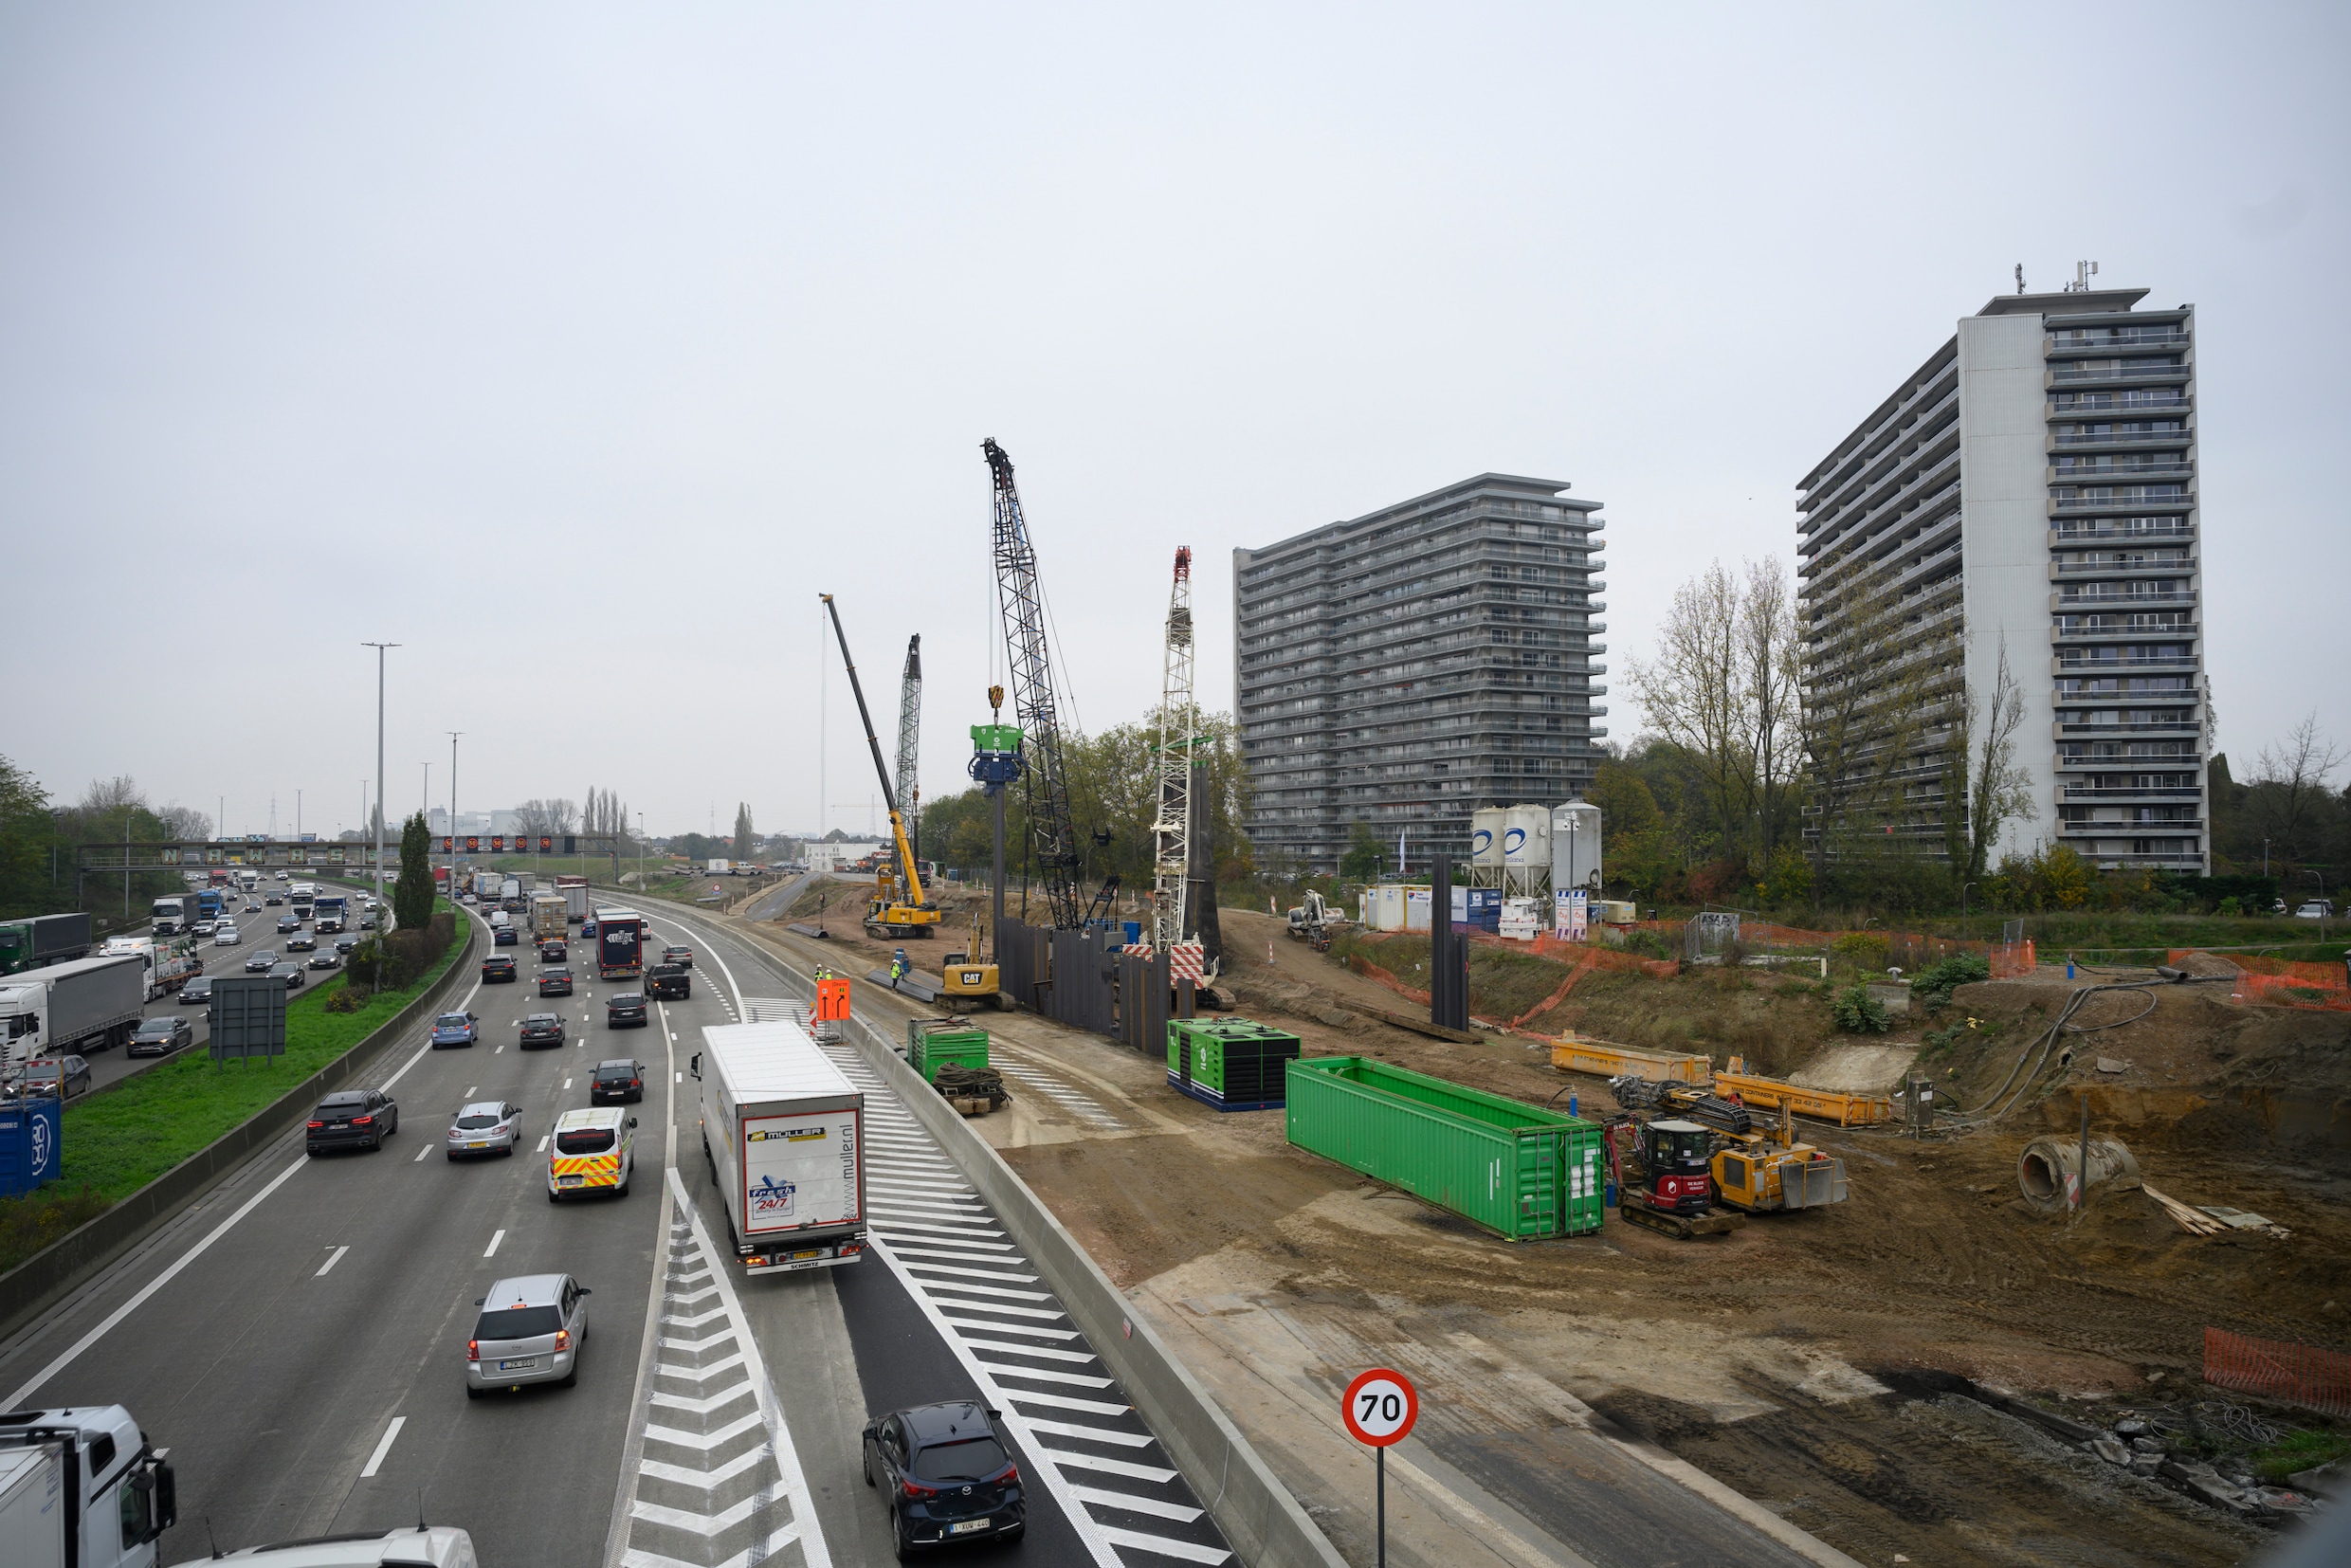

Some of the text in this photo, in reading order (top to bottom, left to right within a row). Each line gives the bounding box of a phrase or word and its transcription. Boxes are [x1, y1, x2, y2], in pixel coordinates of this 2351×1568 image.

[963, 973, 981, 984] CAT
[1731, 1085, 1745, 1095] MAES
[1745, 1088, 1775, 1100] CONTAINERS
[839, 1124, 855, 1215] www.muller.nl
[752, 1186, 793, 1196] fresh
[758, 1197, 788, 1210] 24/7
[791, 1261, 819, 1269] SCHMITZ
[1361, 1394, 1400, 1422] 70
